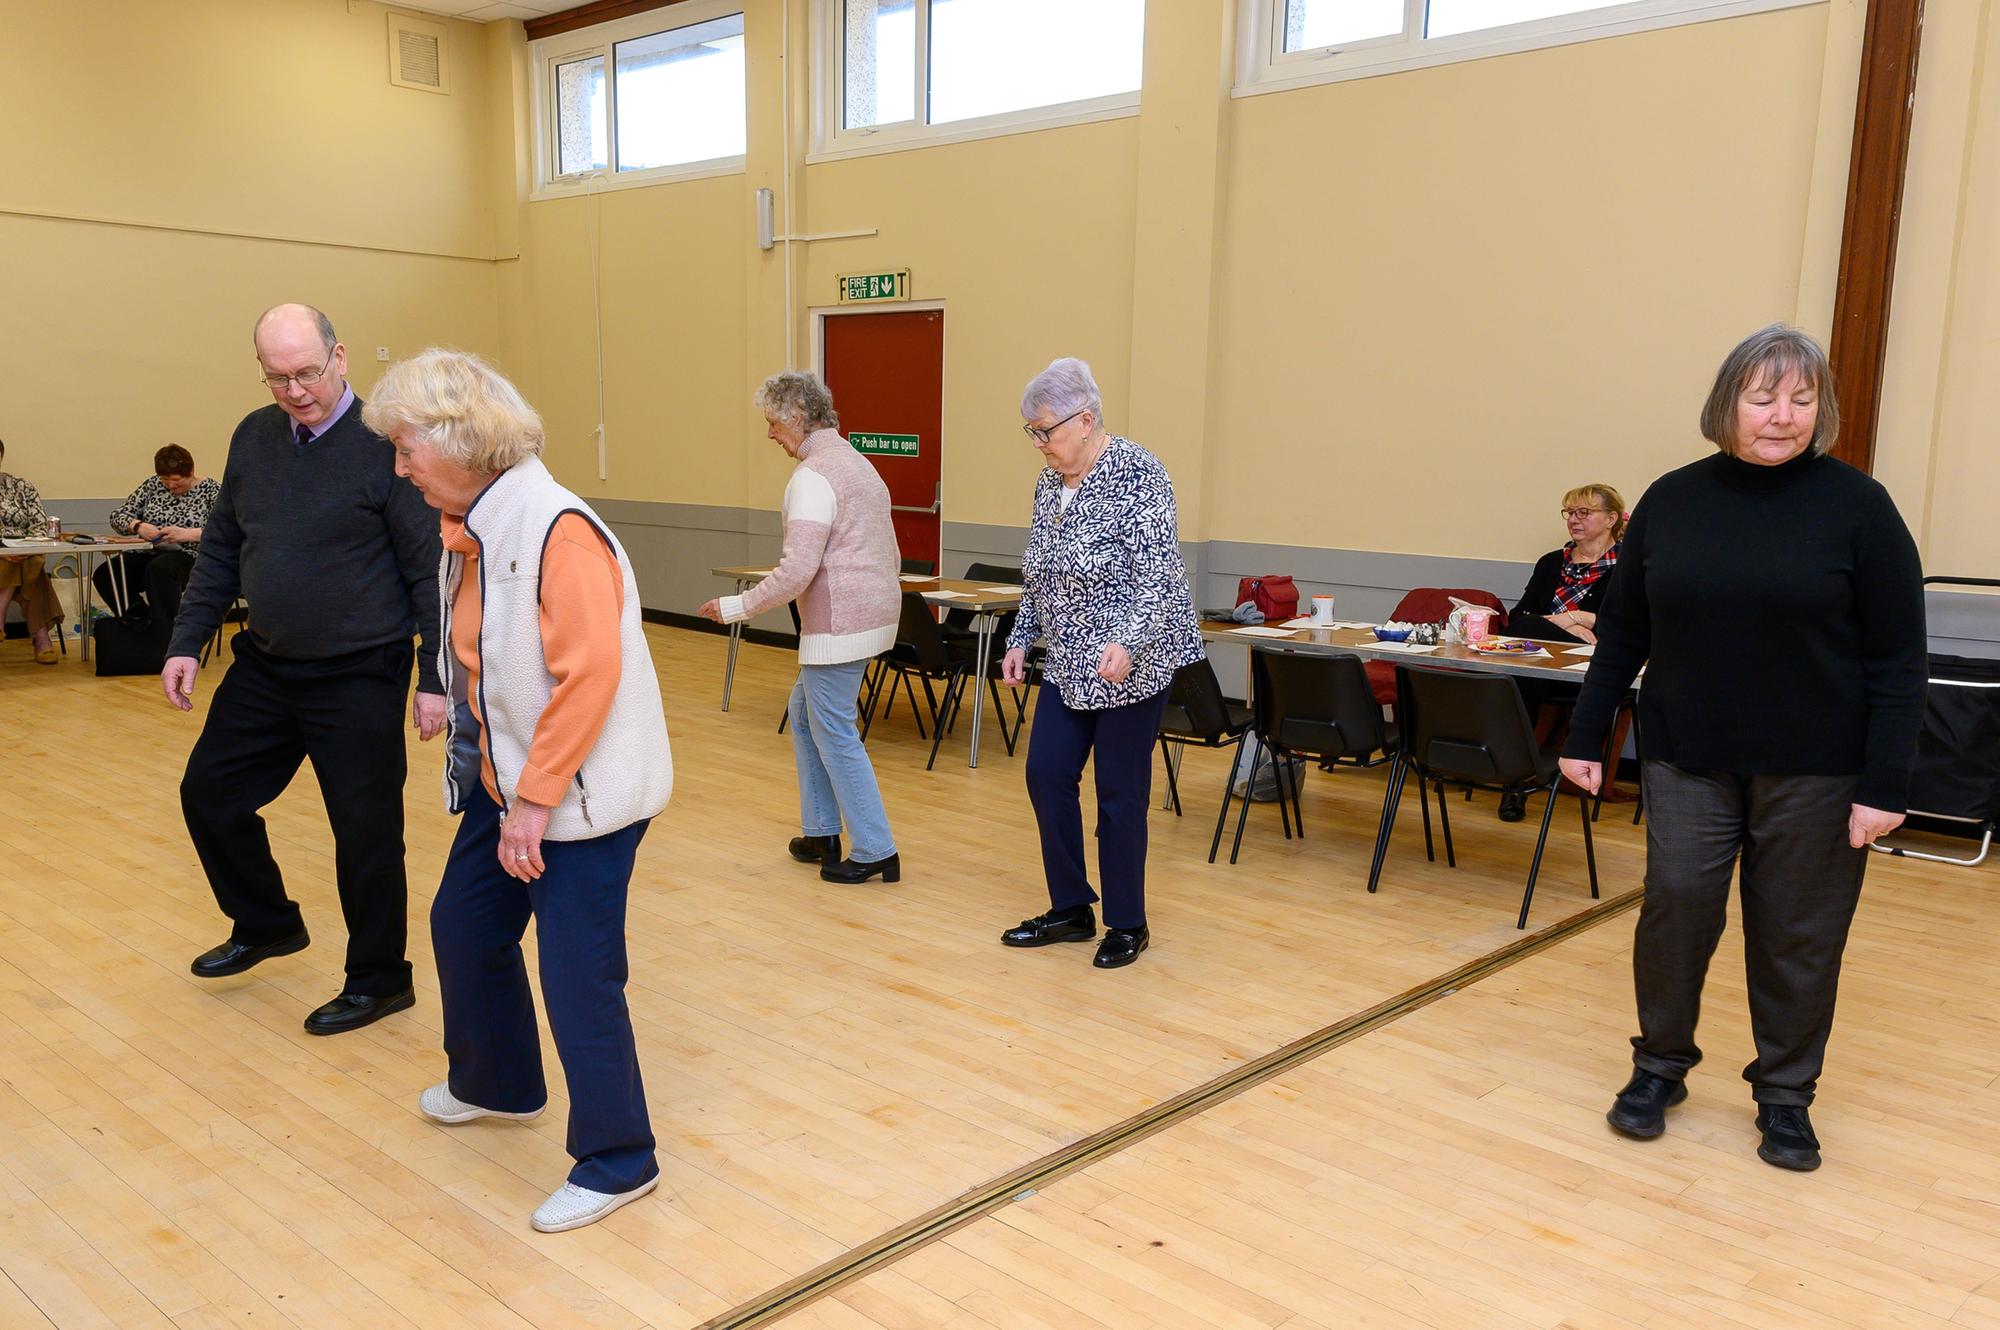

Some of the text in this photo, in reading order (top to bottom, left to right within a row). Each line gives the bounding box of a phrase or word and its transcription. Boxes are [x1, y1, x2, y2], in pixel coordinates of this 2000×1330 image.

[849, 277, 867, 288] FIRE
[849, 288, 868, 299] EXIT
[861, 436, 917, 452] Push bar to open
